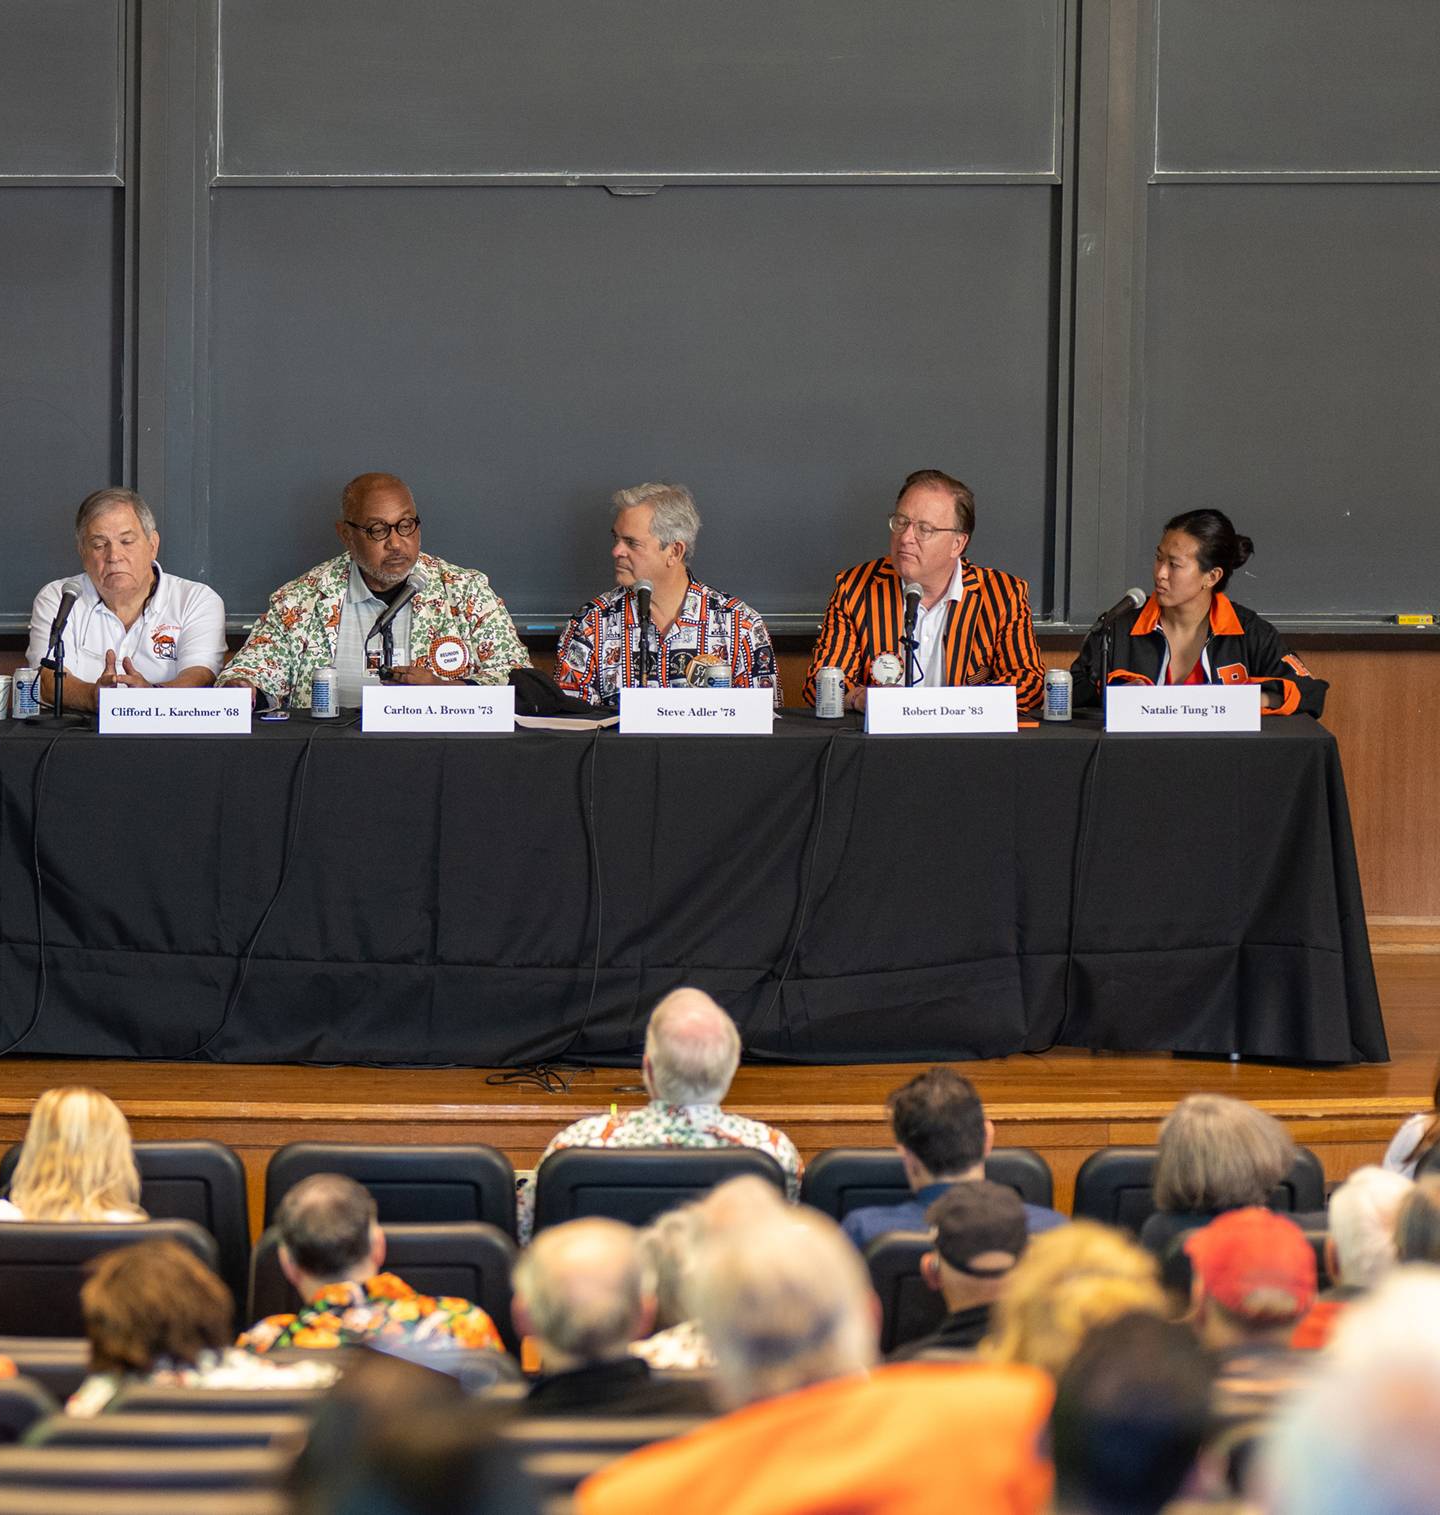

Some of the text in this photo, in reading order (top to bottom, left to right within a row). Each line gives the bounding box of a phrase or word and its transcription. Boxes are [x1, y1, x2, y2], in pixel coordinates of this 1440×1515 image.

[111, 707, 152, 717] Clifford
[155, 707, 166, 717] L.
[168, 707, 222, 717] Karchmer
[383, 705, 423, 715] Carlton
[425, 705, 438, 715] A.
[441, 705, 475, 715] Brown
[656, 707, 686, 717] Steve
[688, 707, 718, 717] Adler
[902, 706, 937, 716] Robert
[940, 706, 966, 716] Doar
[1141, 705, 1179, 715] Natalie
[1181, 705, 1209, 718] Tung
